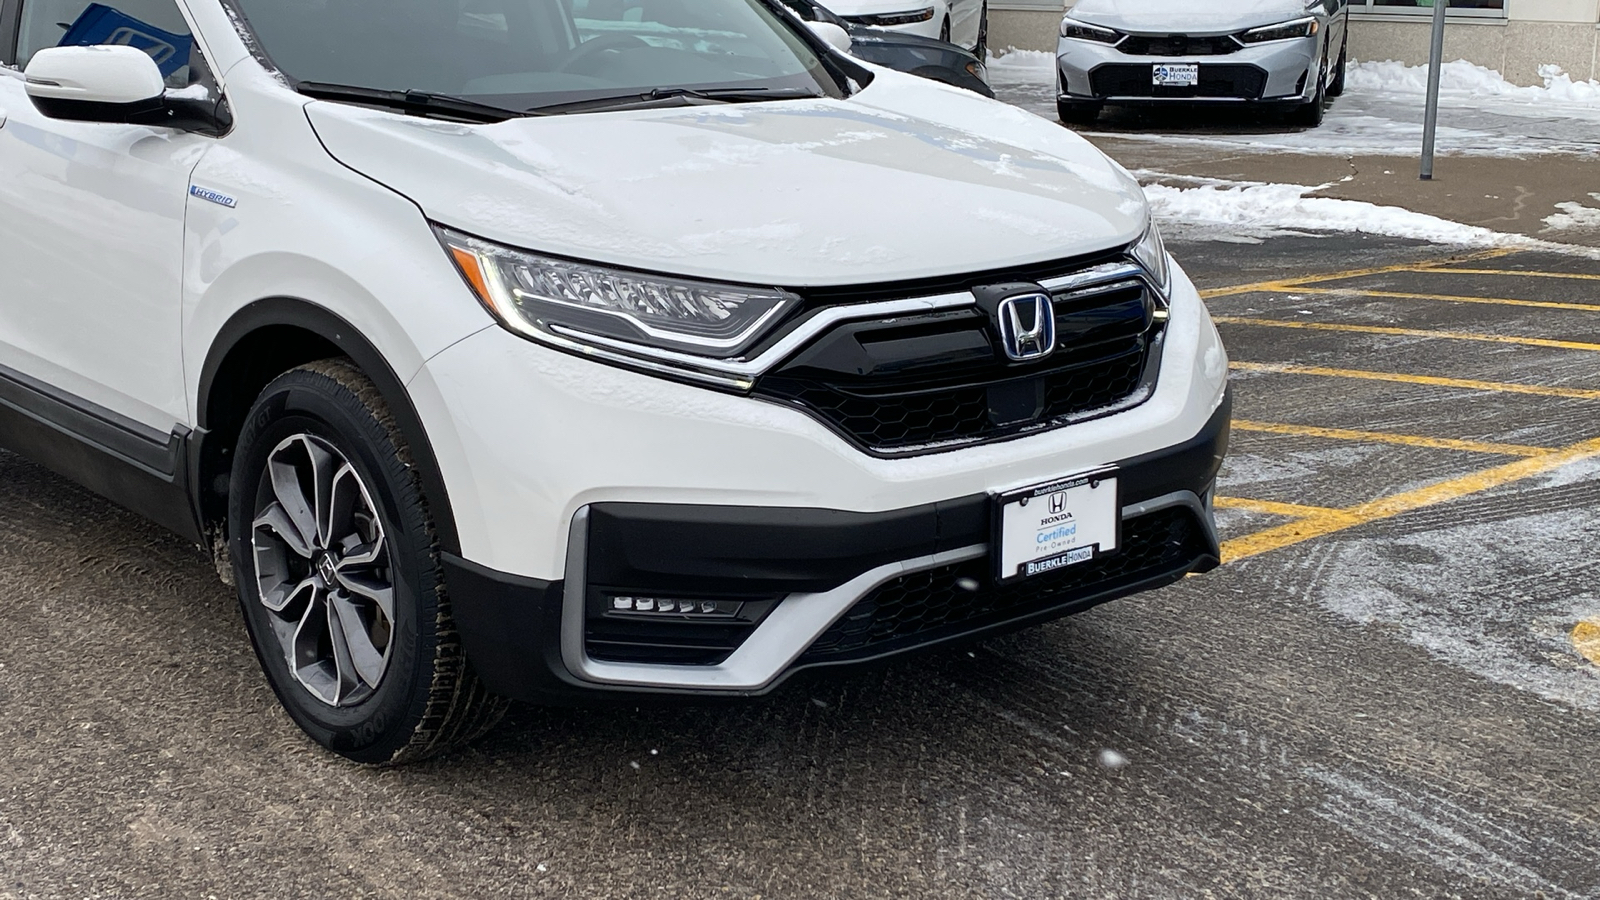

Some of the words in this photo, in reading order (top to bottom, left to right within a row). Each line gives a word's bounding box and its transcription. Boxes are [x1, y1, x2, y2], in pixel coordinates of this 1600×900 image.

[1169, 72, 1197, 80] HONDA
[196, 189, 233, 204] HYBRID
[1033, 478, 1089, 496] buerklehonda.com
[1040, 512, 1073, 526] HONDA
[1036, 524, 1076, 543] Certified
